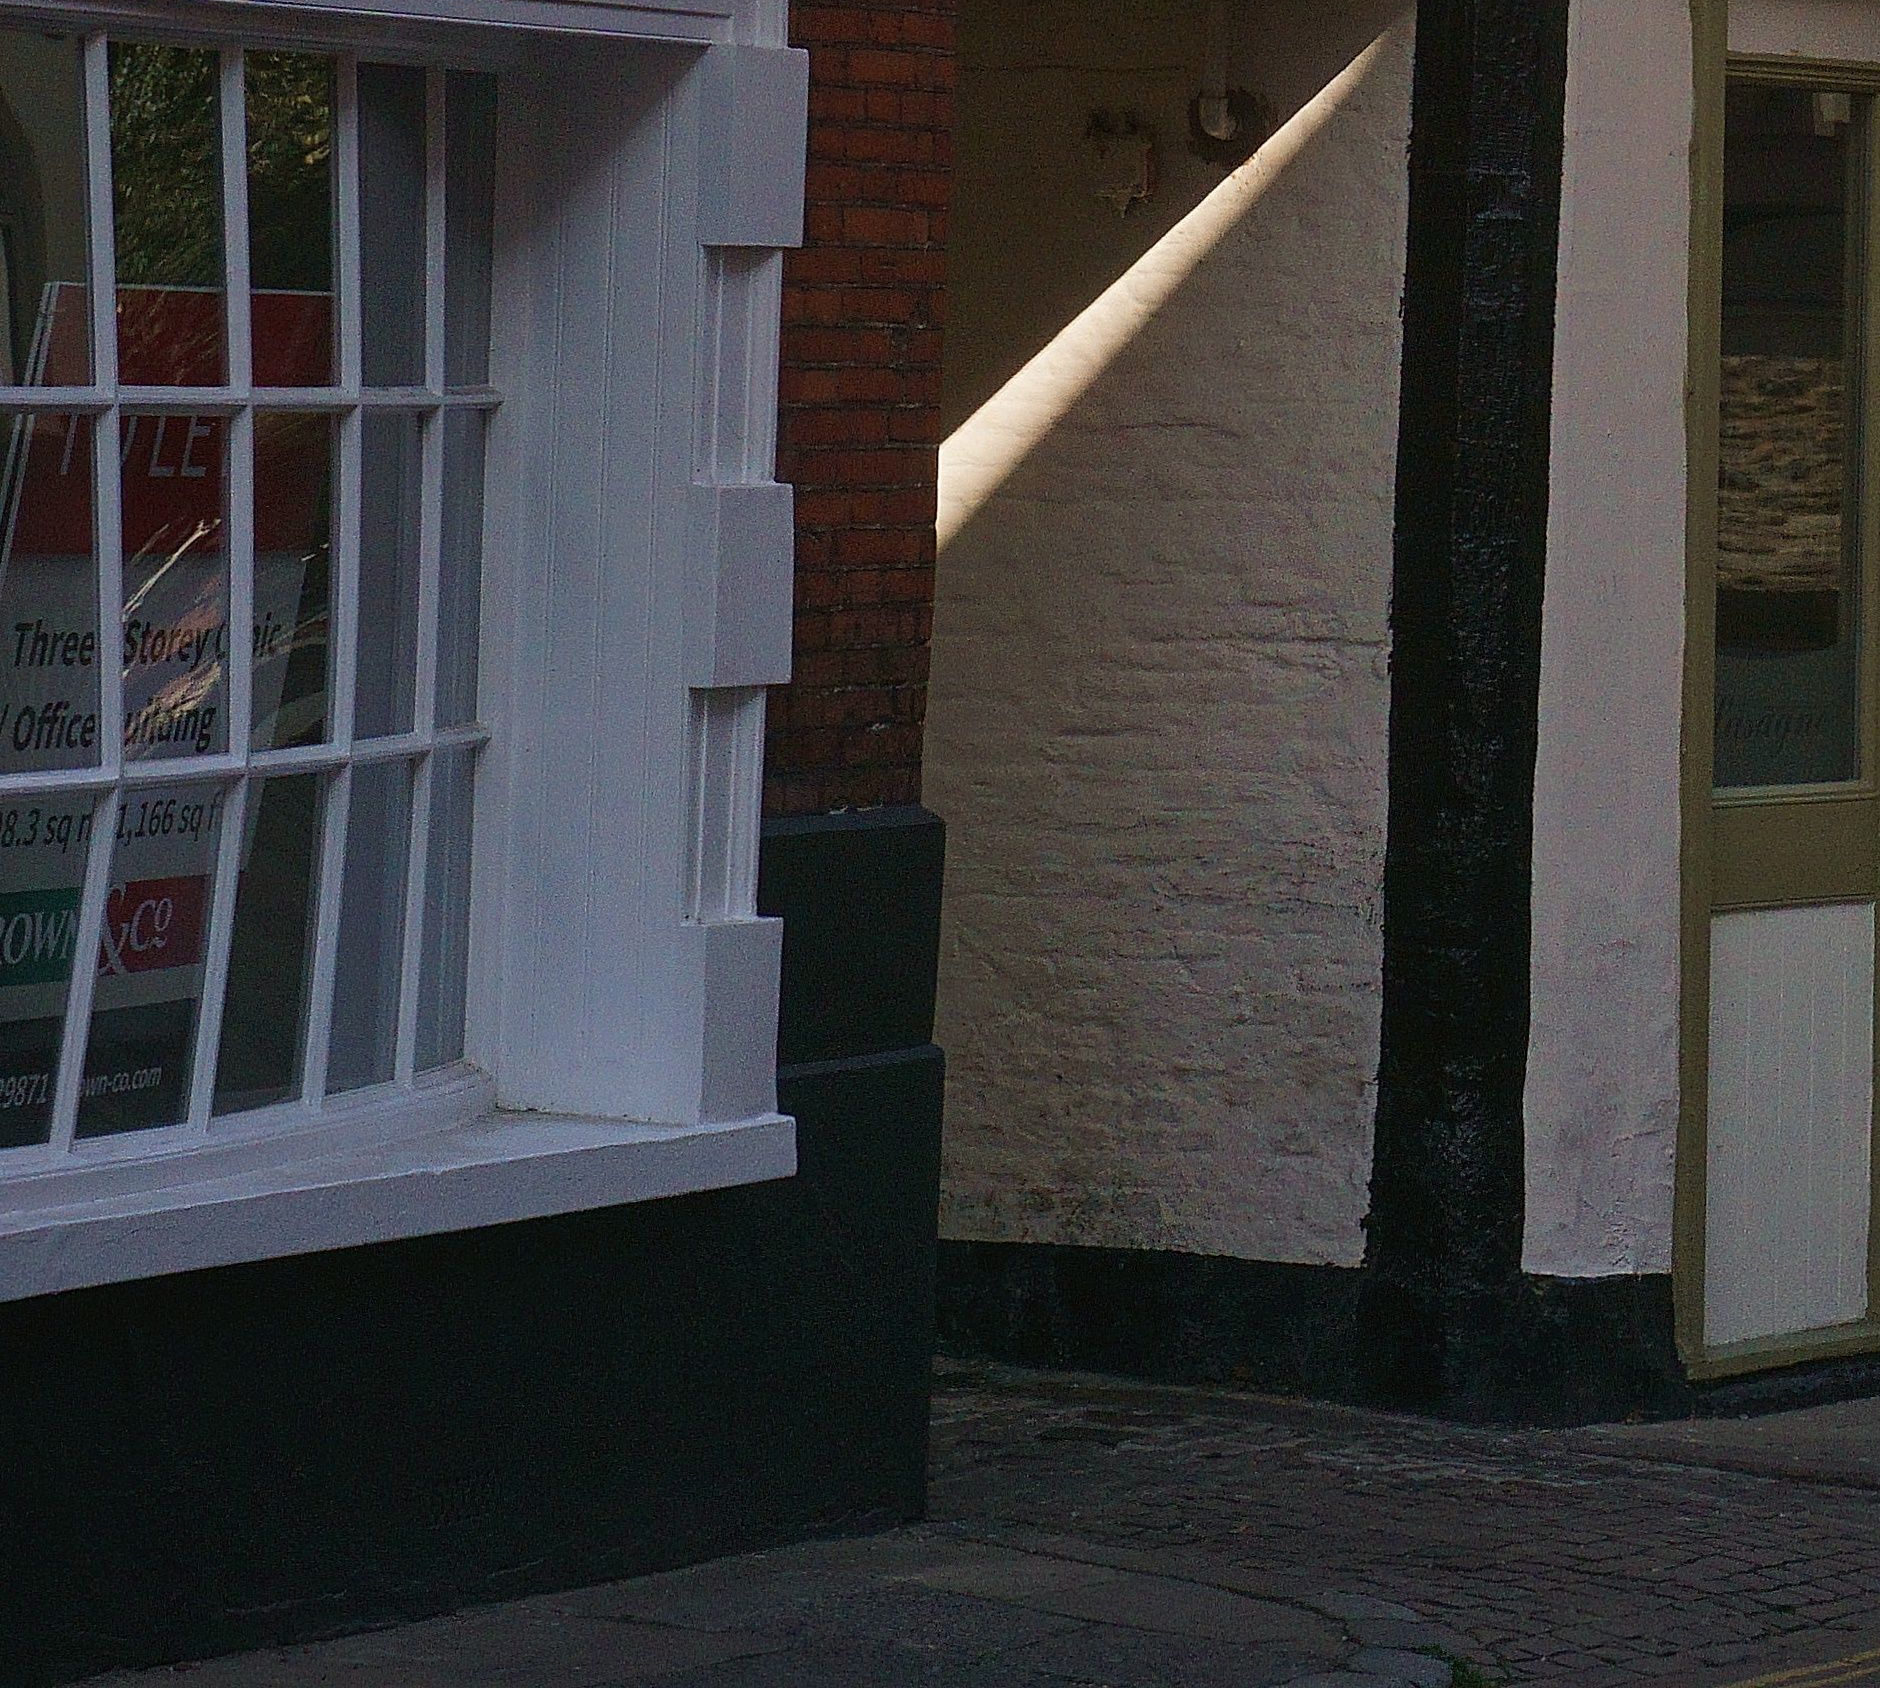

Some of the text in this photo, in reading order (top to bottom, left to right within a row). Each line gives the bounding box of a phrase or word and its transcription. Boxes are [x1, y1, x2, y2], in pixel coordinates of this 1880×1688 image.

[14, 620, 96, 667] Three
[123, 619, 211, 668] Storey
[13, 701, 96, 751] Office
[123, 698, 216, 752] uilding
[43, 814, 72, 853] sq
[117, 799, 177, 847] 1,166
[178, 802, 204, 842] sq
